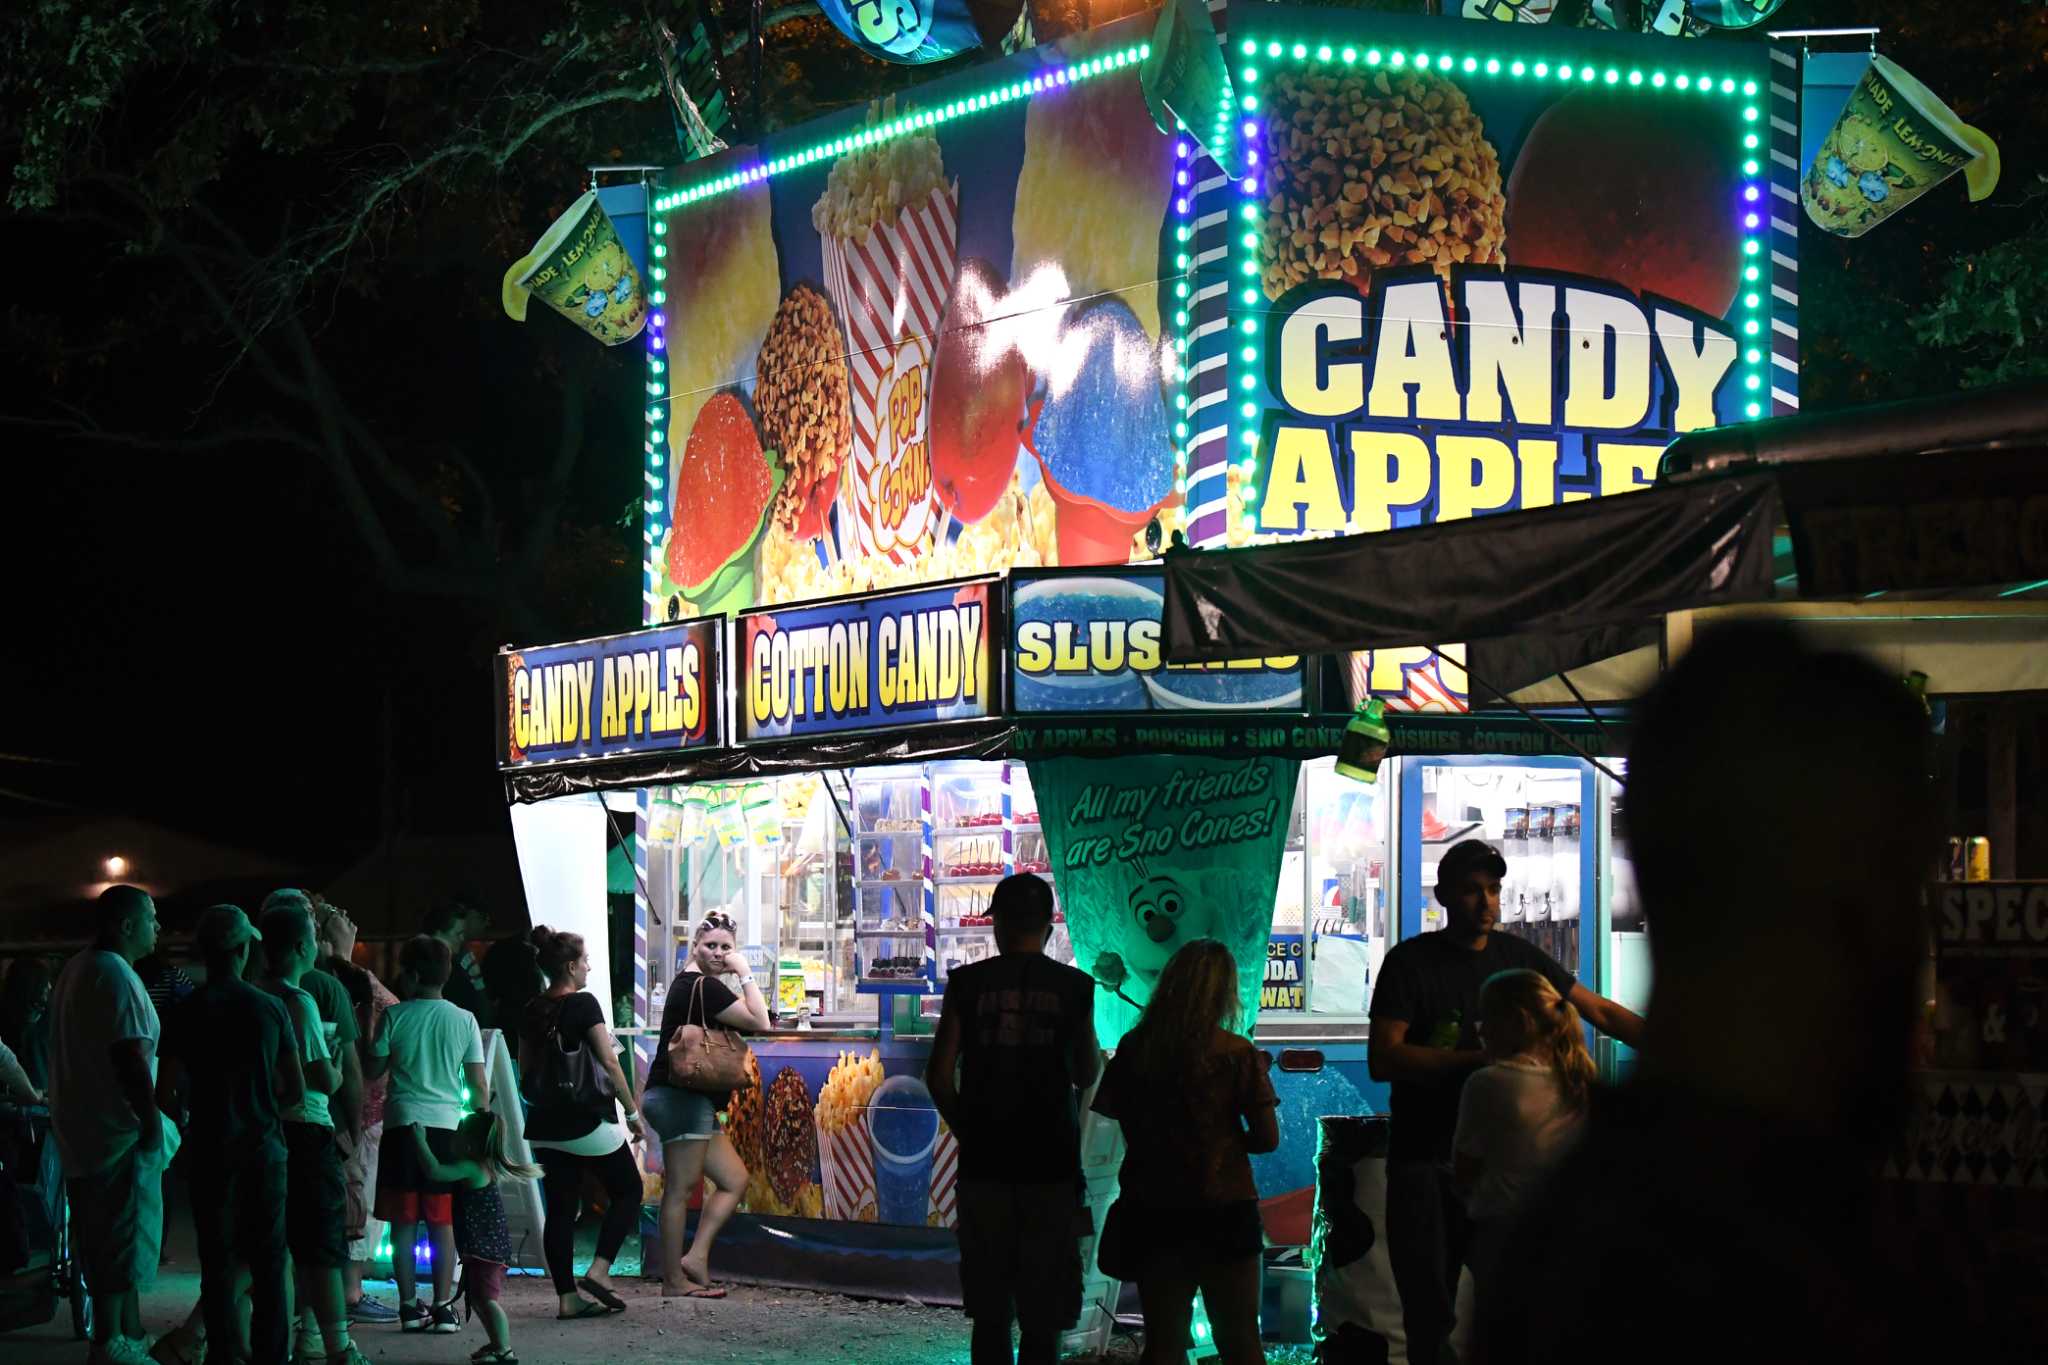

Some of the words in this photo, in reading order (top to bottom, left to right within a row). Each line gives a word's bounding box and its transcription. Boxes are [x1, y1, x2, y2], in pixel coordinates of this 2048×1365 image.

[1280, 279, 1738, 433] CANDY
[889, 364, 923, 462] POP
[752, 618, 869, 722] COTTON
[878, 604, 983, 708] CANDY
[1017, 619, 1300, 672] SLUS
[513, 656, 594, 746] CANDY
[601, 642, 700, 739] APPLES
[1042, 727, 1118, 750] APPLES
[1135, 726, 1225, 749] POPCORN
[1244, 726, 1286, 749] SNO
[1387, 728, 1463, 752] USHIES
[1070, 785, 1110, 823] All
[1112, 786, 1158, 821] my
[1162, 757, 1269, 806] friends
[1064, 838, 1112, 867] are
[1118, 823, 1175, 859] Sno
[1179, 799, 1278, 846] Cones!
